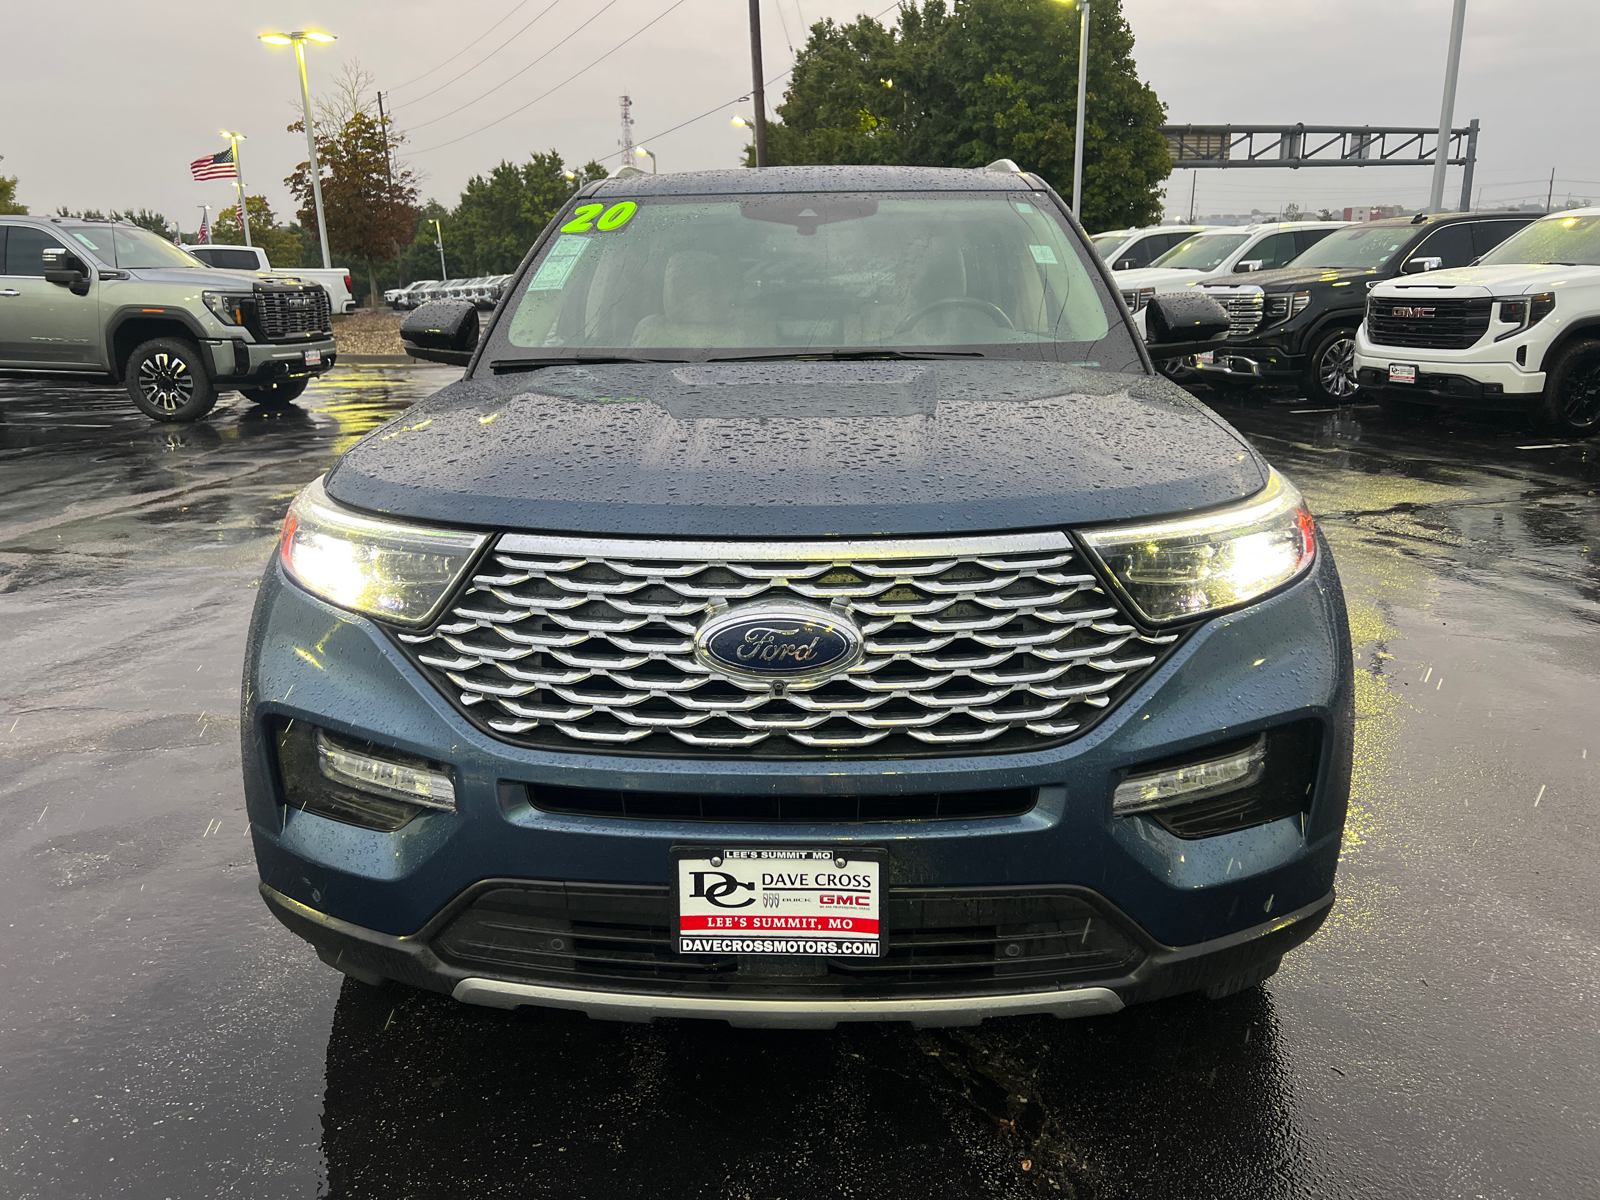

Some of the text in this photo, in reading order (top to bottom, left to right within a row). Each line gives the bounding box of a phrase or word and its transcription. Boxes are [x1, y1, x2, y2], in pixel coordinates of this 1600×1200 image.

[560, 201, 638, 234] 20
[1392, 306, 1436, 319] GMC
[736, 627, 820, 662] Ford
[726, 851, 831, 860] LEE'S SUMMIT MO
[762, 873, 871, 888] DAVE CROSS
[820, 894, 870, 906] GMC
[753, 917, 822, 930] SUMMIT,
[828, 918, 853, 929] MO
[683, 939, 877, 954] DAVECROSSMOTORS.COM
